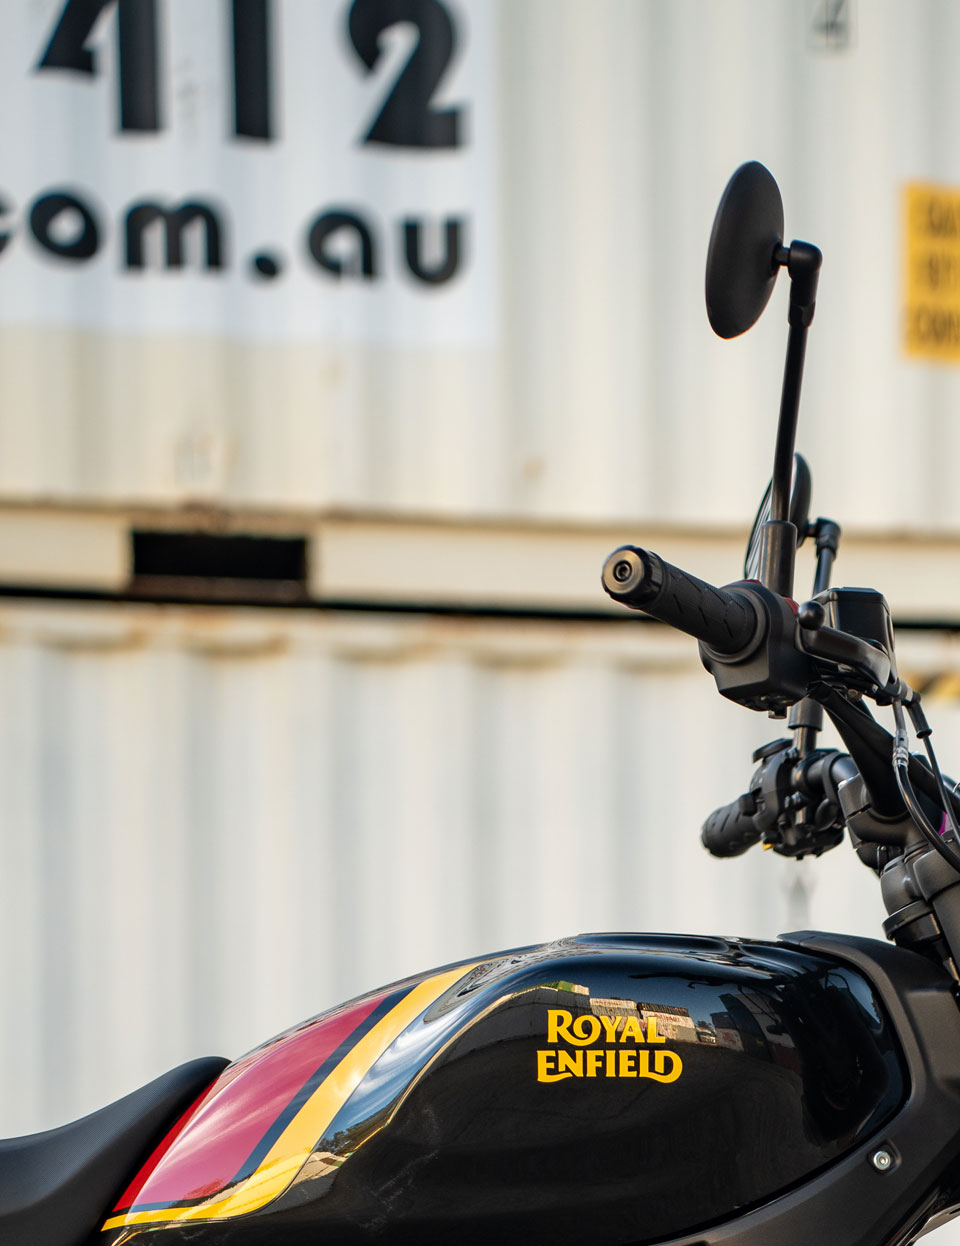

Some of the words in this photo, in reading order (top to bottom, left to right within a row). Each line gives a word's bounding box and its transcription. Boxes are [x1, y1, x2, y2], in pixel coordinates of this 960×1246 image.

[0, 189, 466, 285] om.au
[547, 1009, 666, 1046] ROYAL
[537, 1050, 683, 1083] ENFIELD
